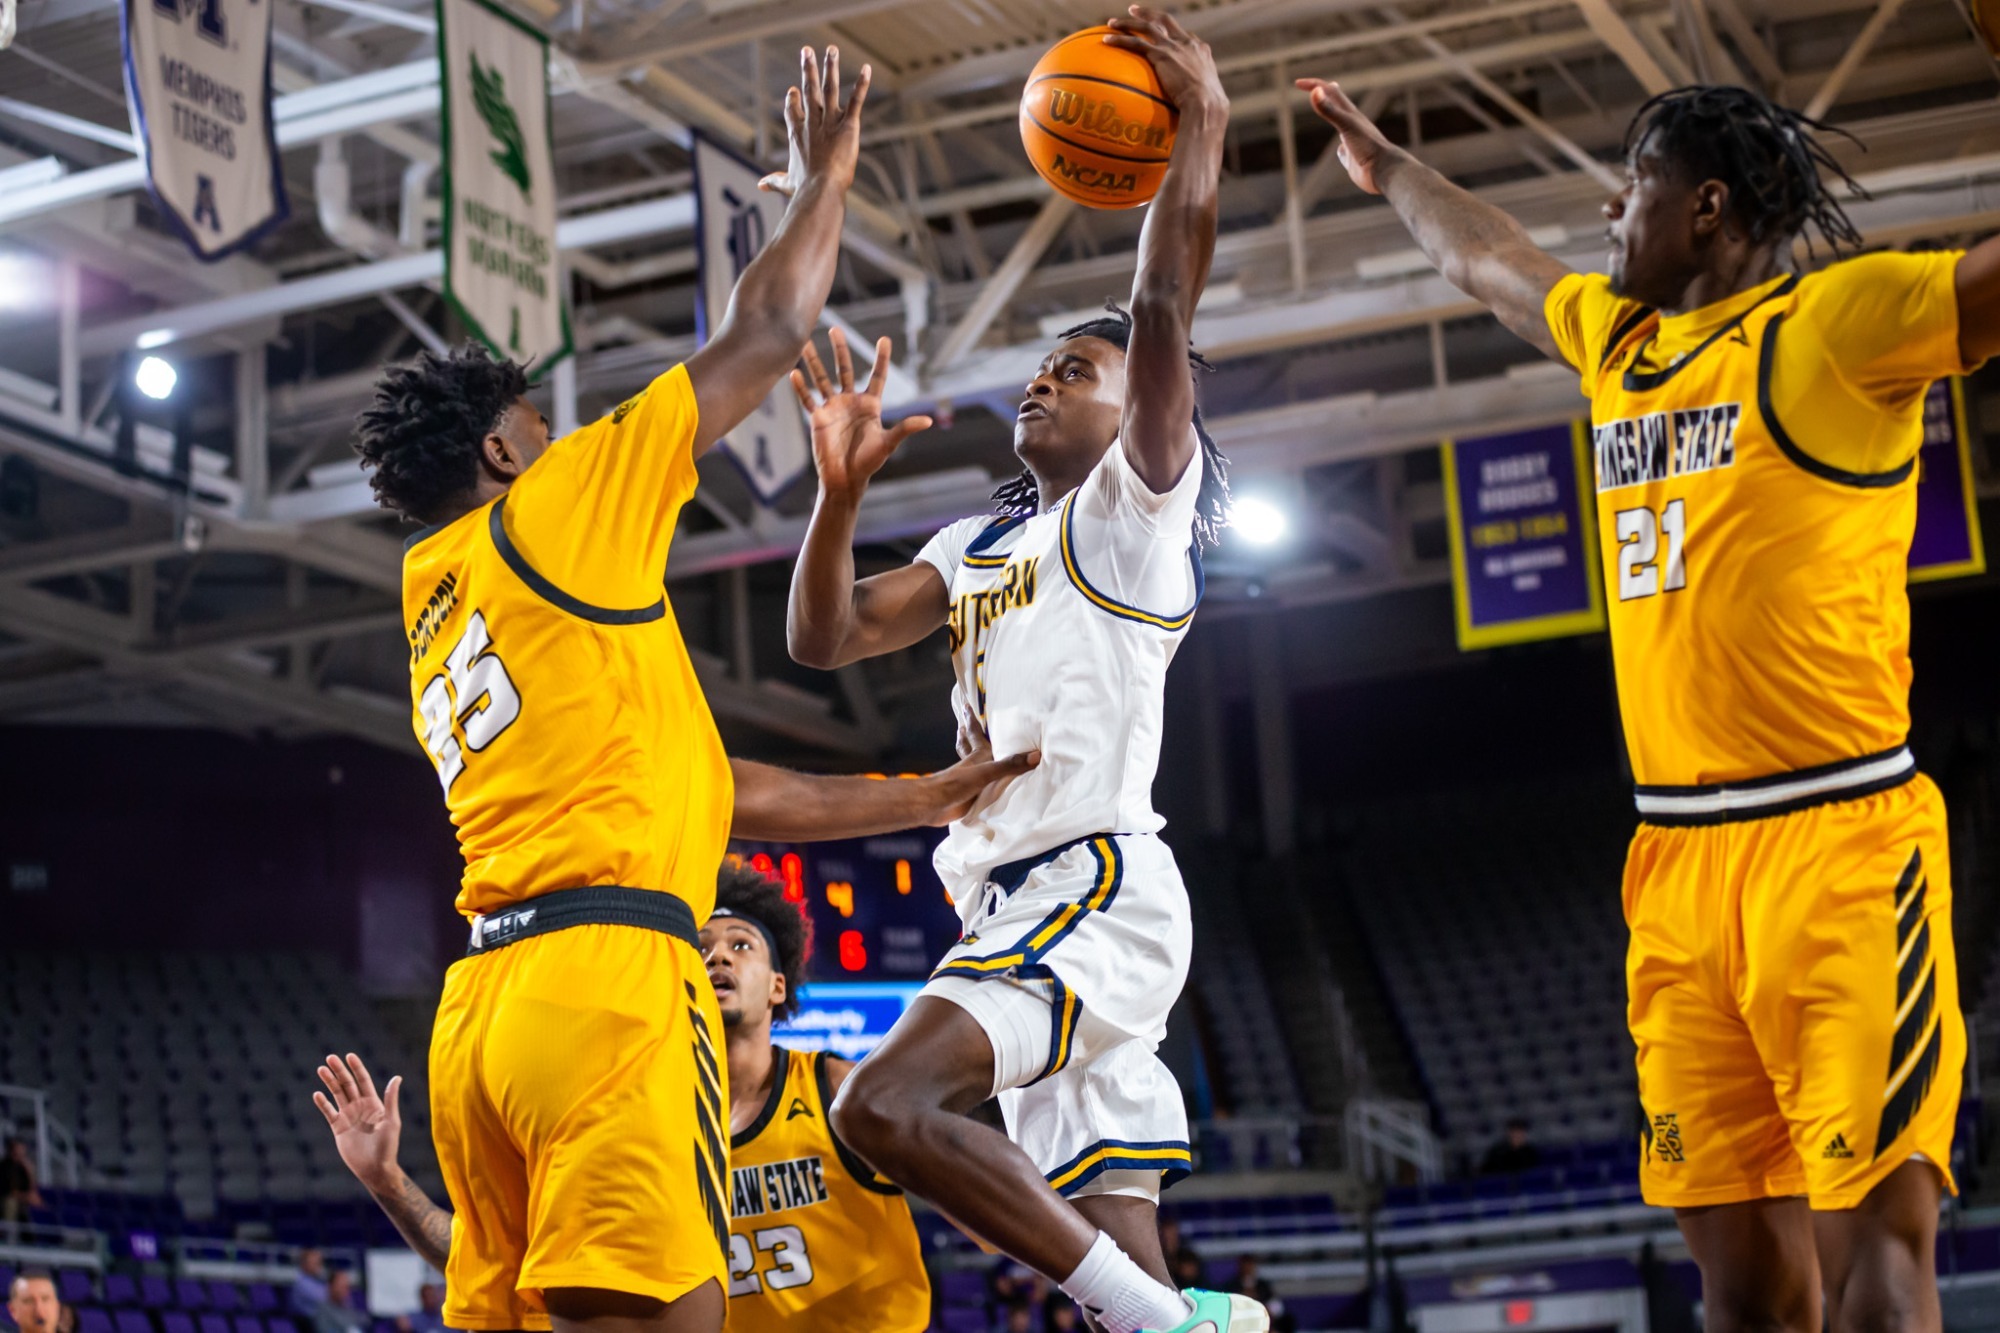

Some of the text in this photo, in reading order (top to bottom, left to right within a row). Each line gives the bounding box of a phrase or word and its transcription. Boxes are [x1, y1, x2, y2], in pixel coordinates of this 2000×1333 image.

[159, 54, 246, 124] MEMPHIS
[1051, 87, 1166, 149] Wilson
[171, 102, 236, 160] TIGERS
[1052, 154, 1136, 192] NCAA
[1673, 402, 1741, 478] STATE
[1614, 498, 1687, 602] 21
[418, 607, 522, 802] 25
[763, 1156, 829, 1212] STATE
[729, 1224, 815, 1299] 23
